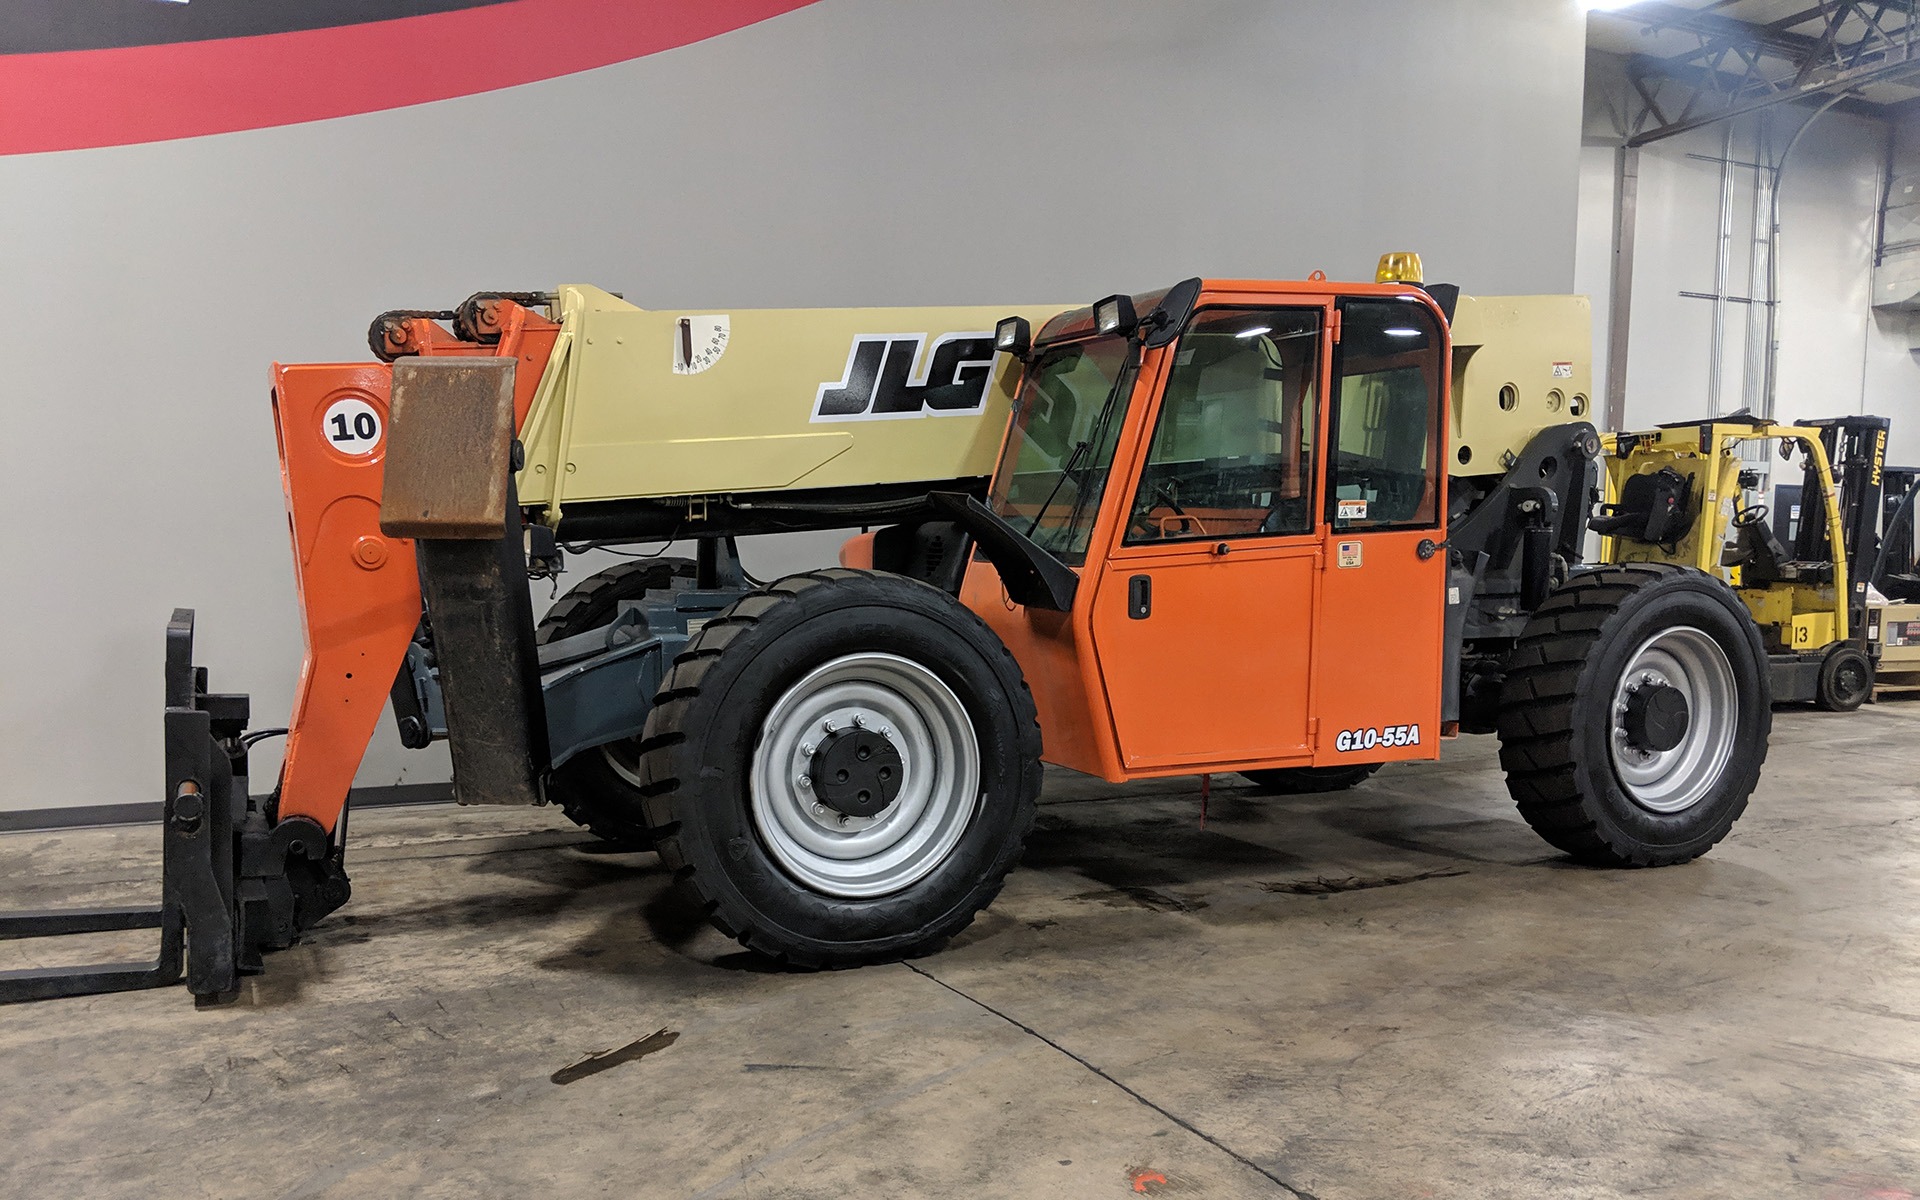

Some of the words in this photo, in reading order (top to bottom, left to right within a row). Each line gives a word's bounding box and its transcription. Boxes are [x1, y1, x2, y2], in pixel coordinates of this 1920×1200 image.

[711, 337, 720, 345] 60
[695, 354, 702, 363] 20
[705, 348, 713, 356] 40
[712, 346, 721, 354] 50
[814, 334, 998, 420] JLG
[331, 412, 377, 441] 10
[1871, 430, 1886, 486] HYSTER
[1794, 626, 1808, 643] 13
[1336, 724, 1420, 752] G10-55A
